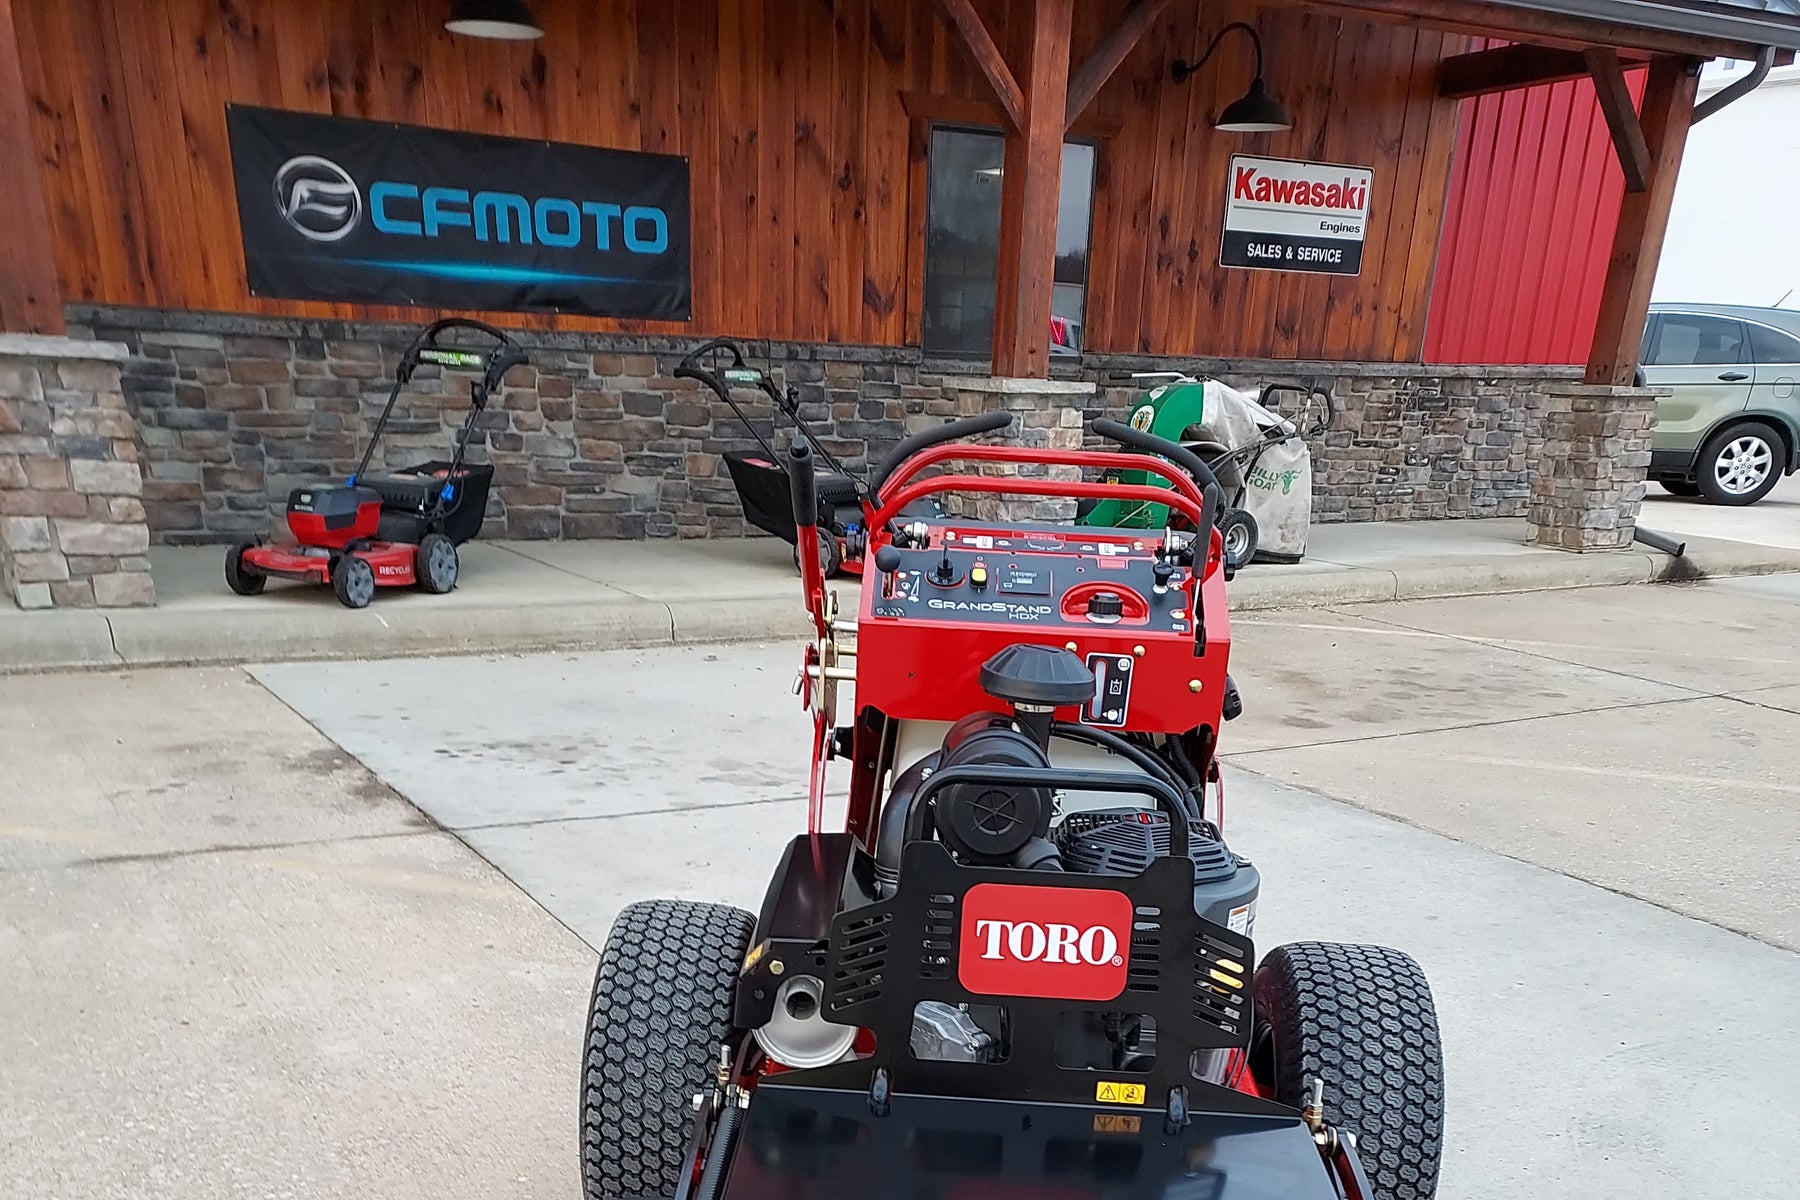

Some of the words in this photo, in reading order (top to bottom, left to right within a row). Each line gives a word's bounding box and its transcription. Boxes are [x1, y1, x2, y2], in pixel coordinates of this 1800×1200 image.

[1234, 166, 1367, 210] Kawasaki
[369, 180, 669, 254] CFMOTO
[1319, 221, 1361, 234] Engines
[1247, 243, 1282, 259] SALES
[1285, 248, 1294, 259] &
[1297, 246, 1343, 263] SERVICE
[1251, 466, 1281, 481] BILLY
[1008, 612, 1039, 620] HDX
[975, 919, 1118, 966] TORO
